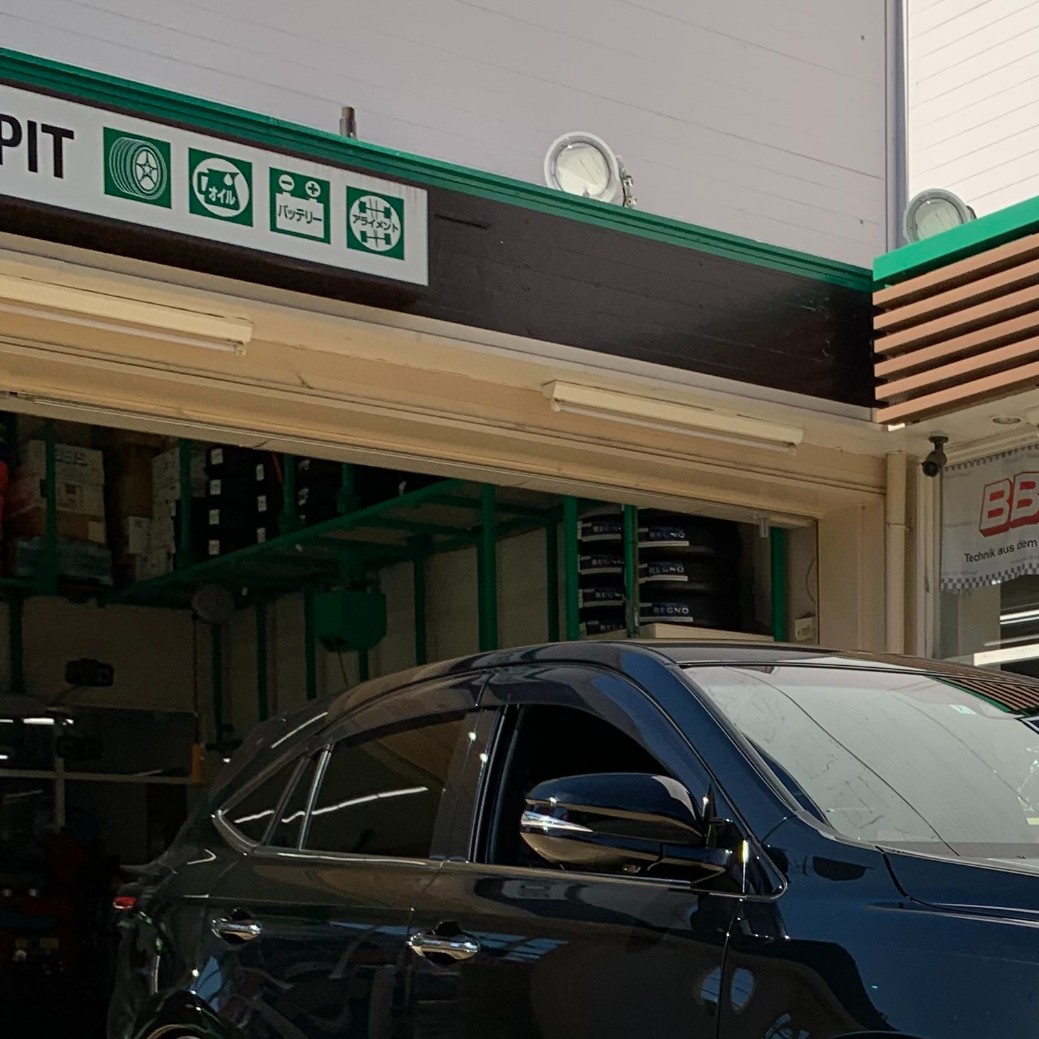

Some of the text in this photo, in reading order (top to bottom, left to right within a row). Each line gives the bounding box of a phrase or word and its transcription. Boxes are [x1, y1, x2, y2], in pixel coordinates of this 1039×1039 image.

[0, 113, 74, 179] PIT
[208, 186, 236, 206] オイル
[277, 204, 323, 225] バッテリー
[352, 214, 399, 234] アライメント
[964, 548, 996, 563] Technik
[997, 545, 1015, 556] aus
[1017, 539, 1038, 549] dem
